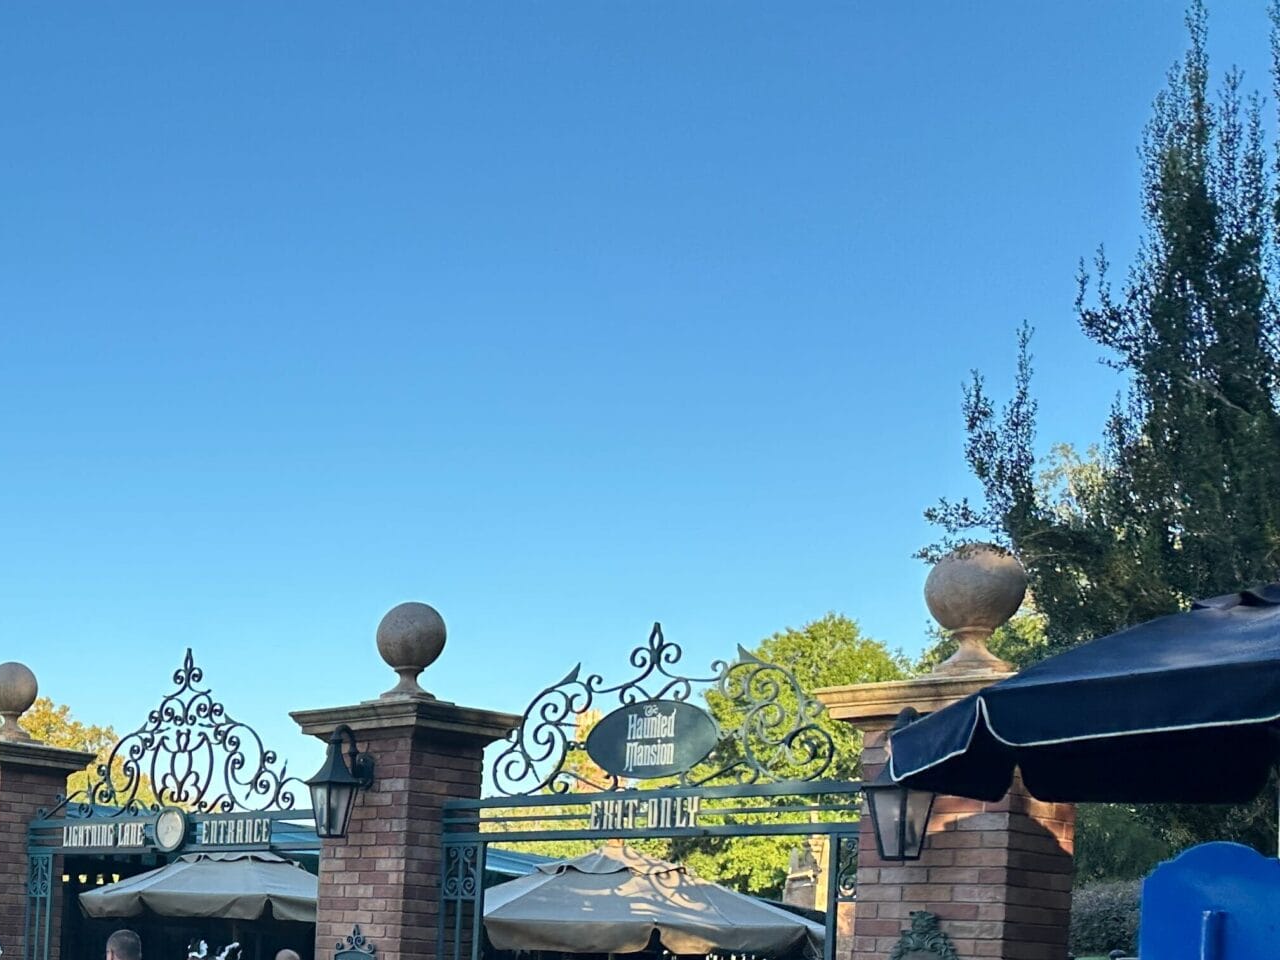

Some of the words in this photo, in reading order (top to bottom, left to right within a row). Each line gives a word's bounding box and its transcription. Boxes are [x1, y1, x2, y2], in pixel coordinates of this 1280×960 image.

[627, 708, 676, 740] Haunted
[623, 740, 675, 772] Mansion
[591, 799, 638, 830] EXIT
[647, 796, 700, 828] ONLY
[62, 824, 115, 848] LIGHTNING
[117, 822, 145, 847] LANE
[202, 818, 270, 845] ENTRANCE
